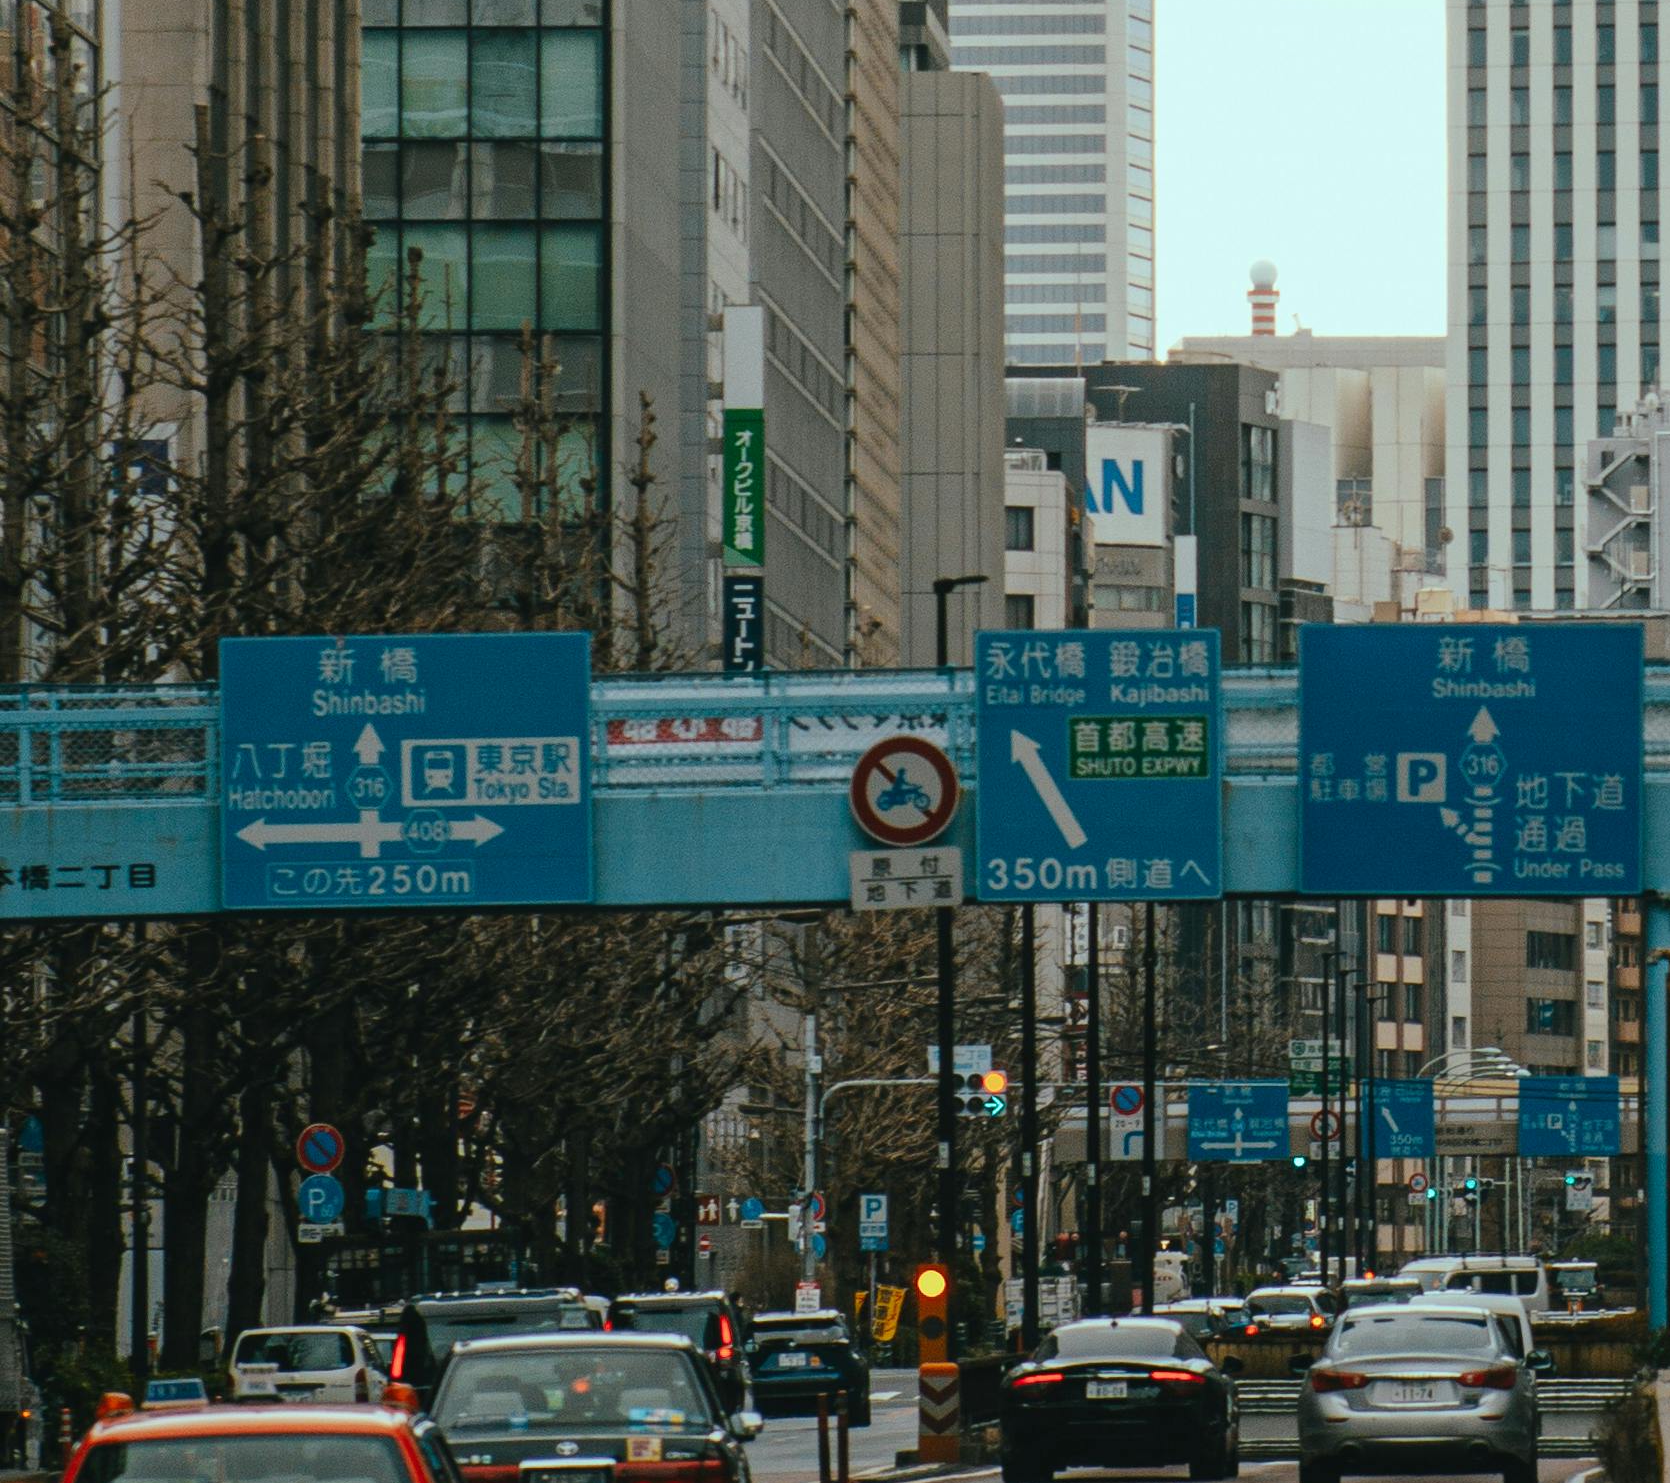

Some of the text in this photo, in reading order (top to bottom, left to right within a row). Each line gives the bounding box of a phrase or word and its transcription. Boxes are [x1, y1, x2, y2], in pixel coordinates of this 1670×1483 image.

[733, 430, 754, 550] オークビル京橋
[319, 647, 419, 685] 新橋
[986, 640, 1209, 680] 永代橋 鍛冶橋
[1437, 636, 1532, 674] 新橋
[312, 690, 426, 716] Shinbashi
[986, 684, 1209, 708] Eitai Bridge Kajibashi
[1432, 678, 1536, 699] Shinbashi
[1073, 719, 1206, 753] 首都高速
[231, 741, 333, 781] 八丁堀
[474, 744, 573, 776] 東京駅
[1076, 757, 1201, 777] SHUTO EXPWY
[1467, 753, 1498, 776] 316
[353, 777, 386, 799] 316
[474, 778, 572, 803] Tokyo Sta.
[1407, 759, 1436, 797] P
[1514, 772, 1626, 811] 地下道
[228, 784, 336, 811] Hatchobori
[408, 820, 447, 842] 408
[1514, 816, 1588, 854] 通過
[272, 865, 471, 898] この先250m
[987, 858, 1211, 891] 350m 側道へ
[1514, 859, 1625, 879] Under Pass
[866, 1198, 882, 1220] P
